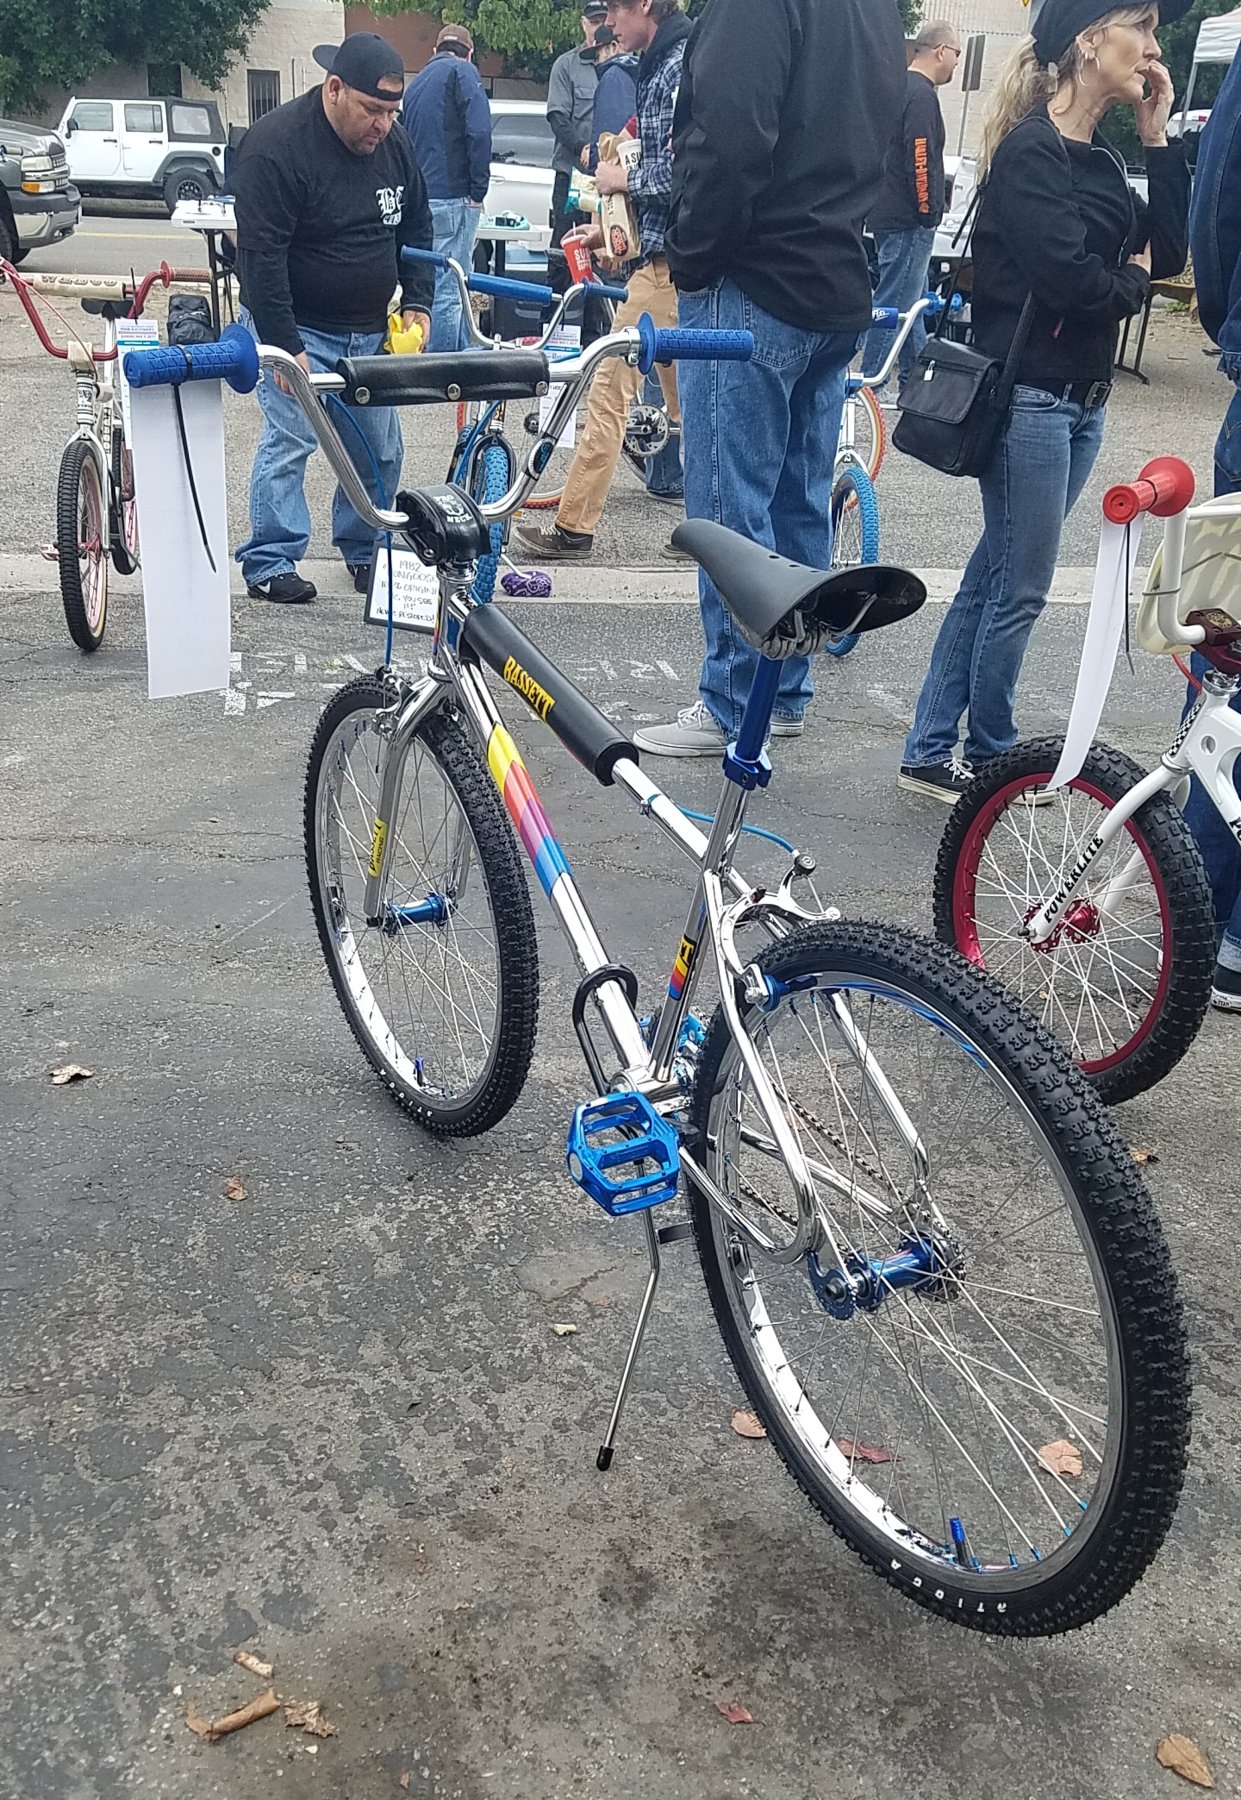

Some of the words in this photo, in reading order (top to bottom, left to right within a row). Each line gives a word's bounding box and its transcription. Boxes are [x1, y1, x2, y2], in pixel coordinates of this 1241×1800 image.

[447, 513, 473, 523] NECK
[393, 570, 439, 583] ONGOOSE
[399, 560, 422, 572] 1982
[503, 655, 556, 723] BASSETT
[376, 837, 384, 865] RACING
[1043, 832, 1105, 924] POWERLITE
[890, 1558, 985, 1613] TIOGA
